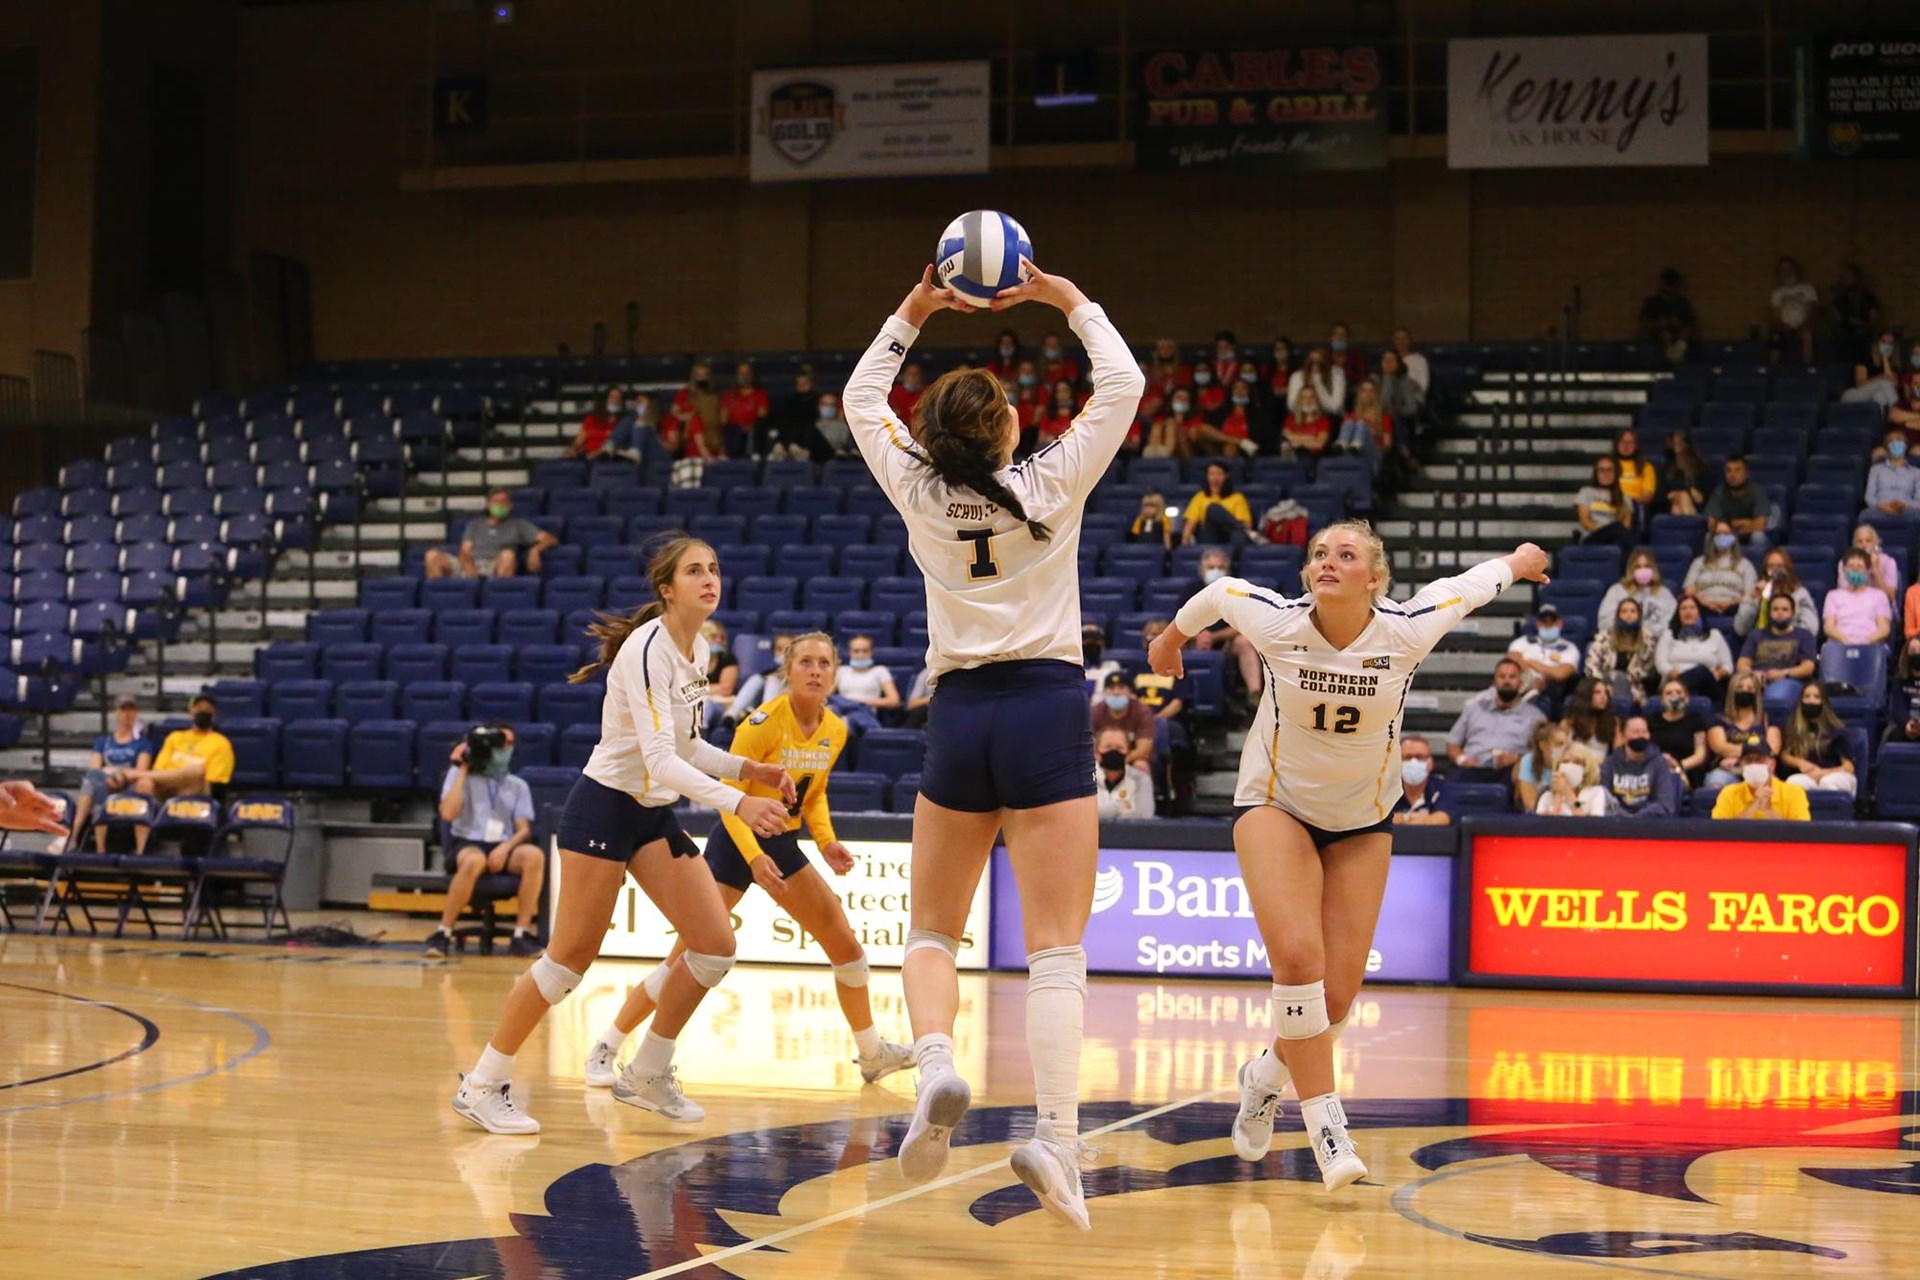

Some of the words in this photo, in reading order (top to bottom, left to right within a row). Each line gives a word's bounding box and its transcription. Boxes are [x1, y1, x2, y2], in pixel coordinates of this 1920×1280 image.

[1829, 42, 1875, 60] pro
[1880, 42, 1920, 55] wo
[1828, 76, 1888, 87] AVAILABLE
[1828, 88, 1853, 98] AND
[448, 90, 473, 122] K
[1147, 98, 1220, 126] PUB
[1227, 97, 1257, 125] &
[1266, 95, 1377, 124] GRILL
[1479, 51, 1683, 151] Kenny's
[946, 503, 998, 522] SCHULZ
[1298, 668, 1379, 686] NORTHERN
[1300, 680, 1376, 697] COLORADO
[1311, 702, 1362, 734] 12
[851, 854, 911, 880] ire
[1485, 887, 1688, 931] WELLS
[1707, 891, 1900, 937] FARGO
[1136, 936, 1241, 972] Sports
